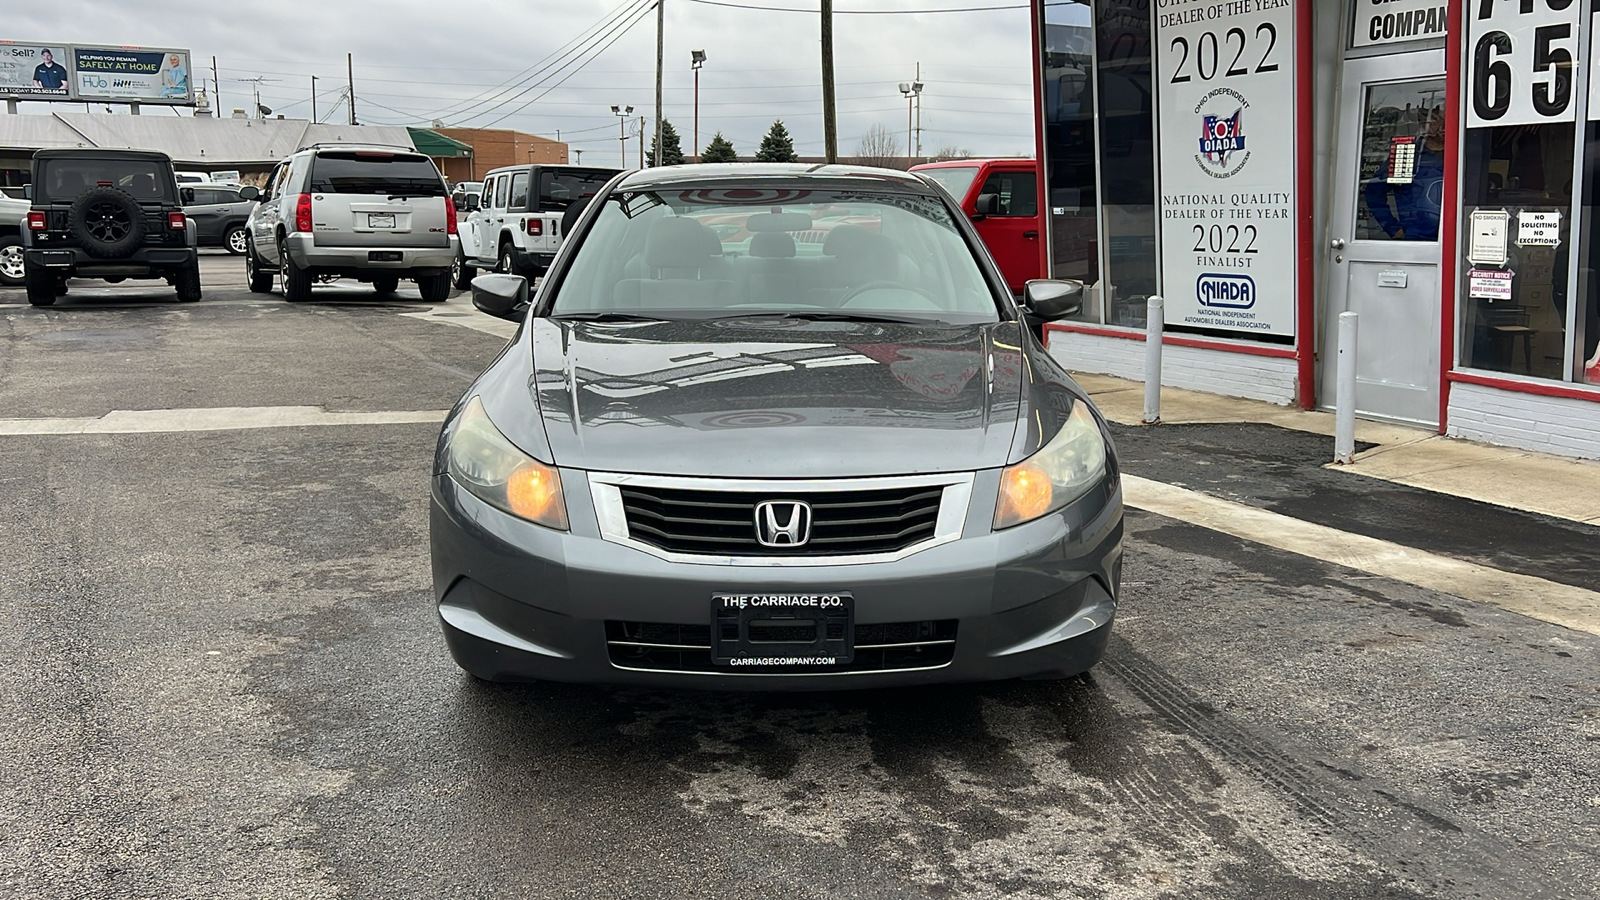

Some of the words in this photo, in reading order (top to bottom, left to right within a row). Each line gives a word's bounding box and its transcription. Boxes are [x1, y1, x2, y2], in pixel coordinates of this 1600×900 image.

[1160, 8, 1204, 28] DEALER
[1207, 4, 1223, 19] OF
[1225, 0, 1251, 16] THE
[11, 48, 35, 57] Sell?
[1170, 22, 1279, 84] 2022
[79, 61, 113, 69] SAFELY
[129, 63, 157, 71] HOME
[1194, 95, 1208, 114] OHIO
[1207, 87, 1250, 109] INDEPENDENT
[1204, 137, 1238, 152] OIADA
[1213, 171, 1231, 179] DEALERS
[1230, 150, 1251, 177] ASSOCIATION
[1163, 194, 1225, 205] NATIONAL
[1231, 192, 1290, 206] QUALITY
[1165, 209, 1206, 219] DEALER
[1210, 209, 1225, 219] OF
[1229, 208, 1252, 218] THE
[1257, 208, 1288, 219] YEAR
[1192, 224, 1258, 254] 2022
[1197, 256, 1252, 268] FINALIST
[1201, 280, 1250, 303] NIADA
[1197, 309, 1221, 317] NATIONAL
[1222, 311, 1256, 320] INDEPENDENT
[1184, 316, 1214, 324] AUTOMOBILE
[1215, 318, 1235, 327] DEALERS
[1236, 320, 1271, 330] ASSOCIATION
[721, 596, 748, 607] THE
[750, 595, 818, 607] CARRIAGE
[821, 595, 843, 607] CO.
[730, 657, 836, 666] CARRIAGECOMPANY.COM
